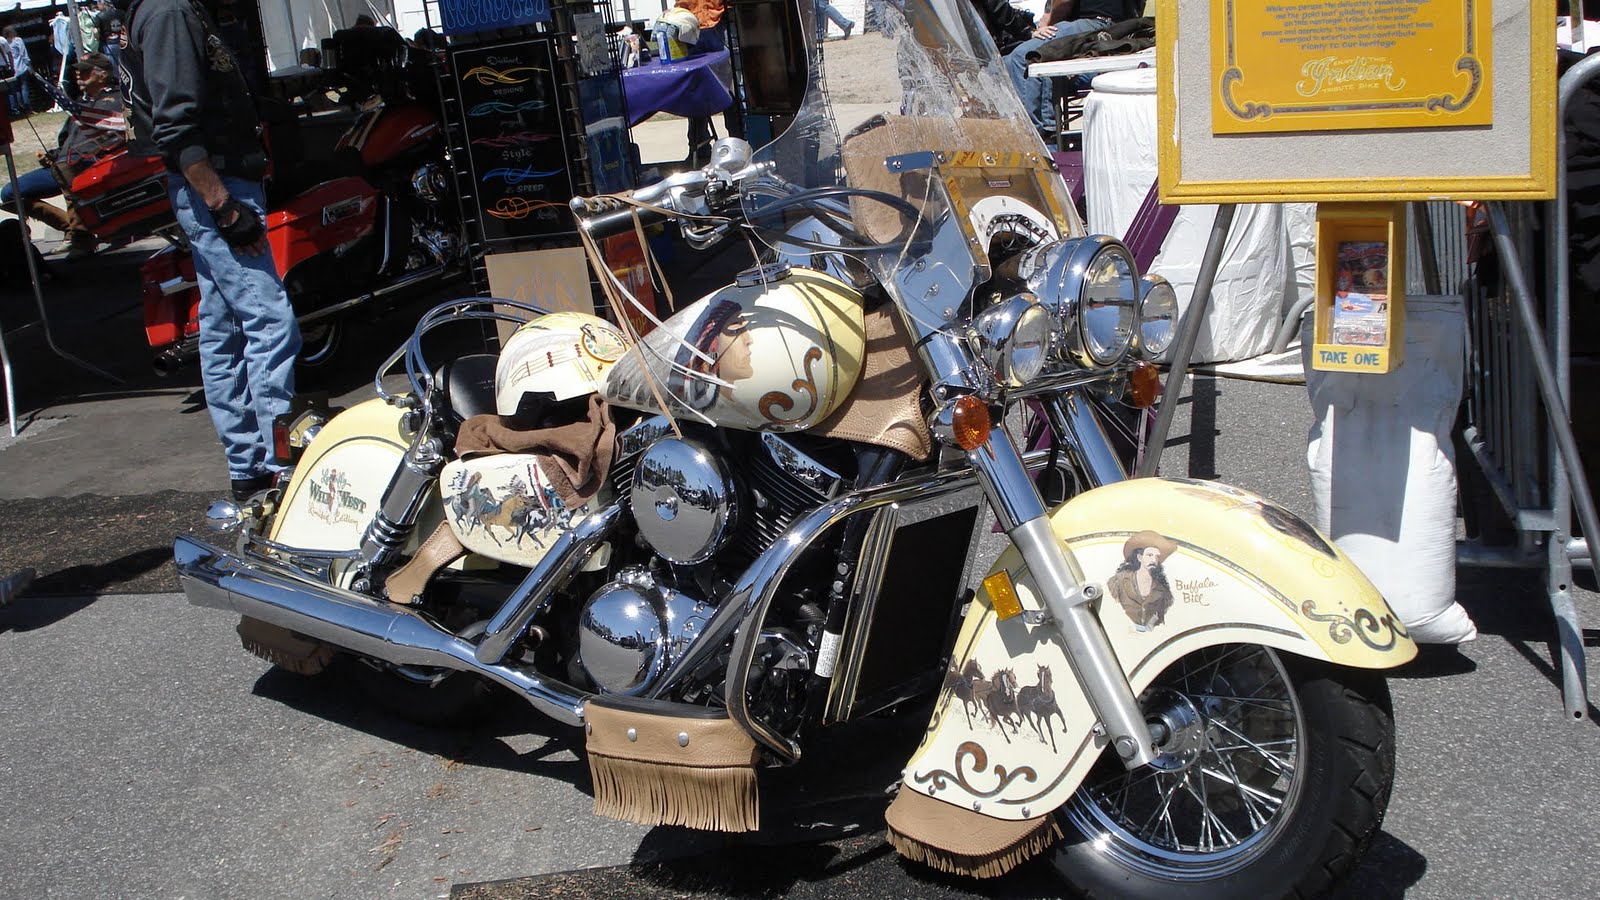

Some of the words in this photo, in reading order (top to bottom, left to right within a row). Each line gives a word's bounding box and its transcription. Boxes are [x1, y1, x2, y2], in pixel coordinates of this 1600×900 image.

[1301, 11, 1320, 19] gold
[1372, 29, 1416, 38] contribute
[1358, 39, 1396, 48] heritage
[1296, 56, 1406, 97] Indian
[1322, 83, 1354, 93] TRIBUTE
[1358, 82, 1379, 90] BIKE
[502, 147, 532, 162] Style
[515, 183, 544, 193] SPEED
[1319, 350, 1347, 364] TAKE
[1354, 353, 1380, 366] ONE
[337, 490, 367, 514] WEST
[1175, 577, 1219, 593] Buffalo
[1183, 592, 1210, 606] Bill
